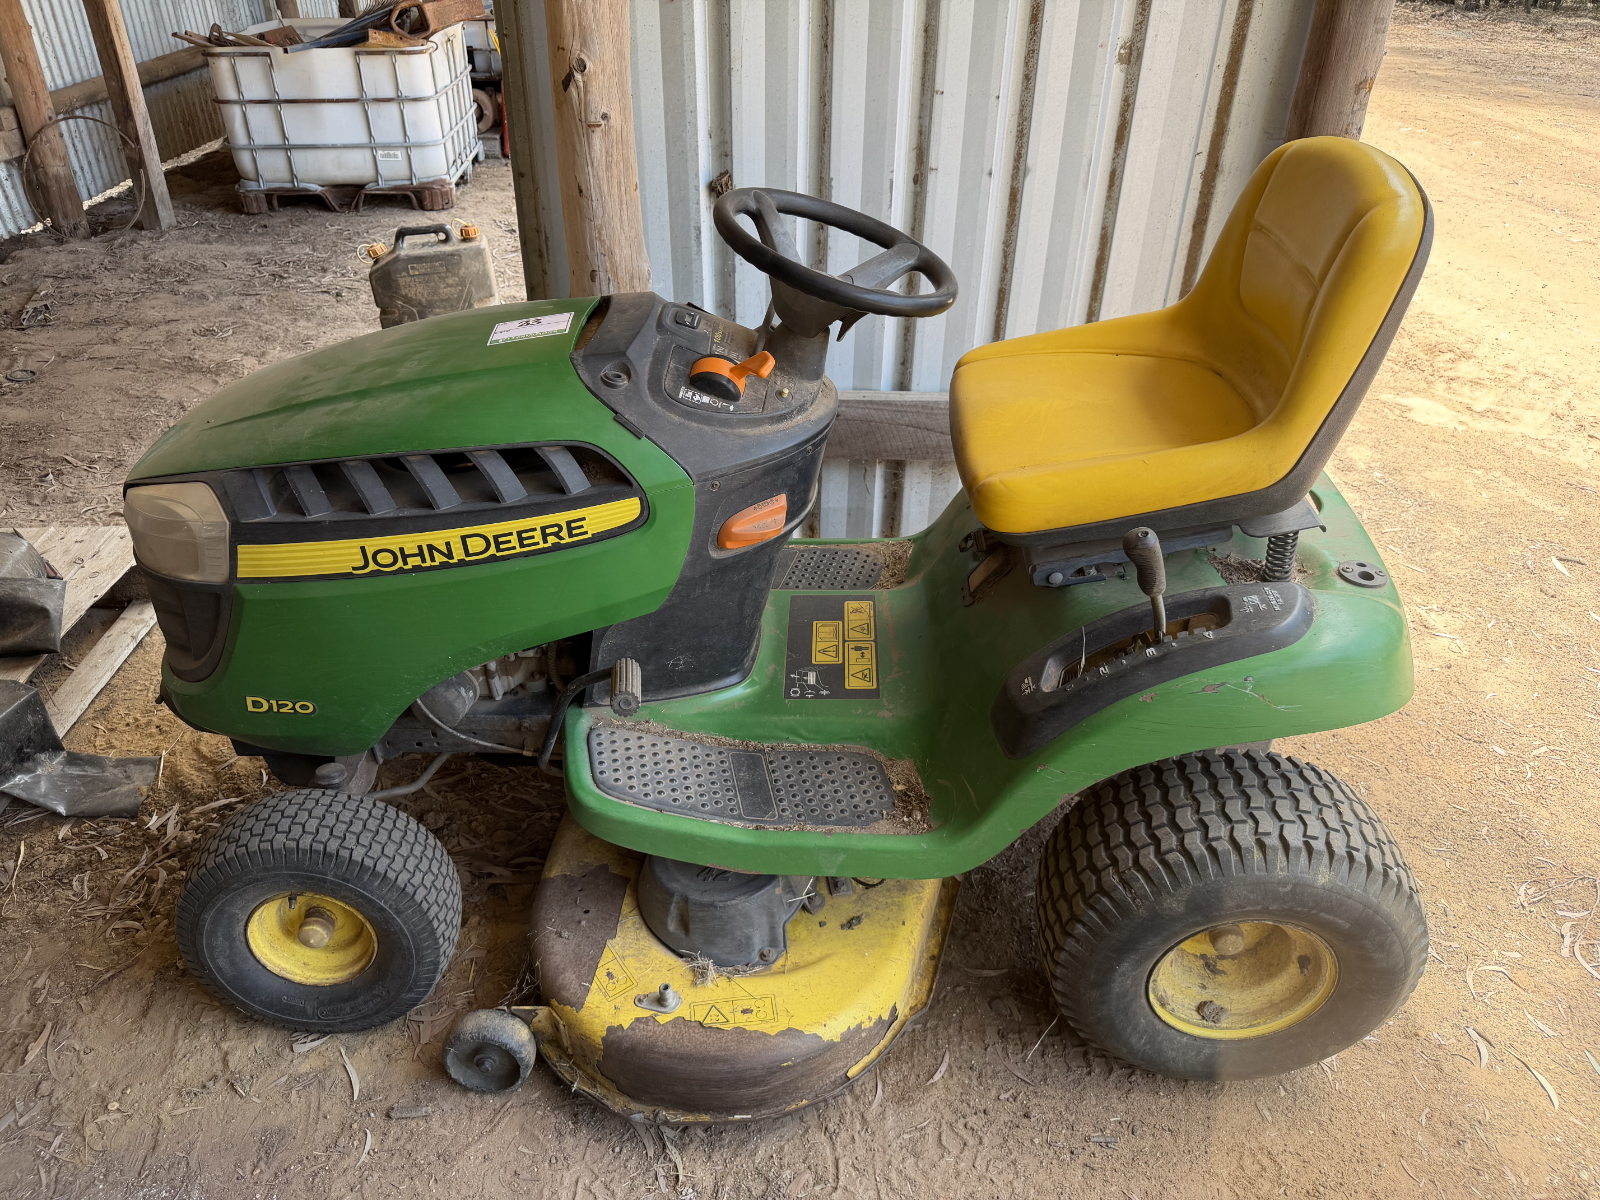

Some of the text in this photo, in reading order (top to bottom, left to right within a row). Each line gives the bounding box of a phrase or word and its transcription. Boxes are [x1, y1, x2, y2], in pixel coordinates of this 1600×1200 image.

[351, 517, 589, 571] JOHN DEERE
[245, 696, 315, 714] D120
